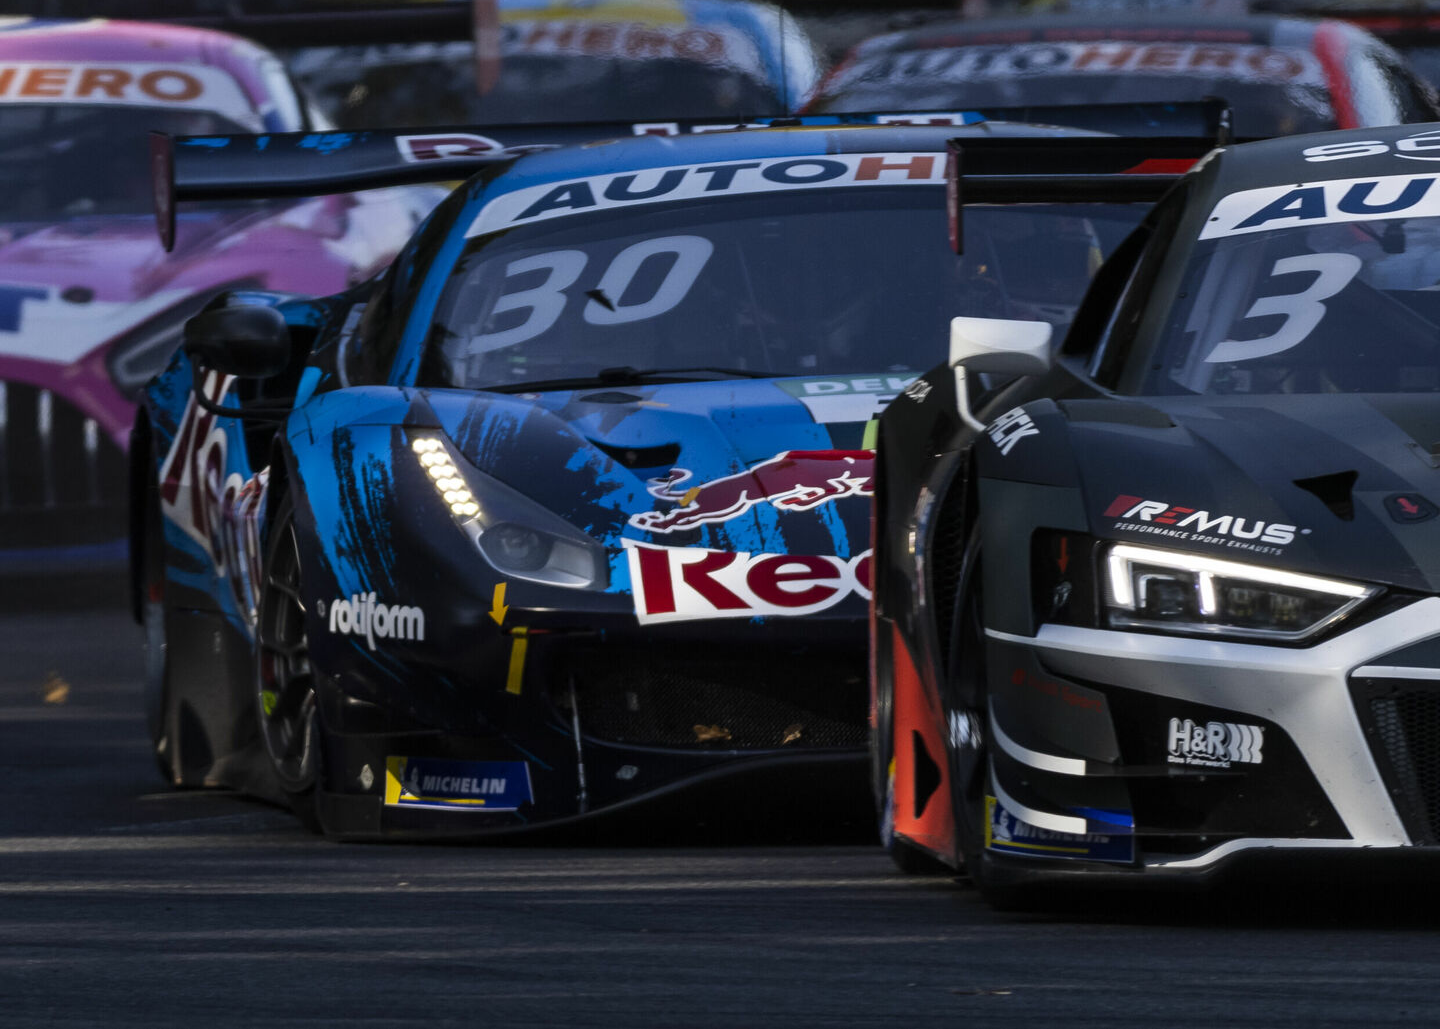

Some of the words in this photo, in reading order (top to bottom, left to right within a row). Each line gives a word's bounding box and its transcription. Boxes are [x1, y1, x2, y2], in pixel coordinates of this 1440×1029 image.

[512, 156, 949, 221] AUTOH
[466, 235, 714, 354] 30
[1205, 253, 1361, 363] 3
[1114, 522, 1187, 539] PERFORMANCE
[1190, 533, 1226, 546] SPORT
[1227, 540, 1283, 556] EXHAUSTS
[1122, 500, 1297, 545] REMUS
[634, 545, 873, 615] Re
[329, 591, 425, 650] rotiform
[1168, 718, 1230, 759] H&R
[422, 775, 507, 794] MICHELIN
